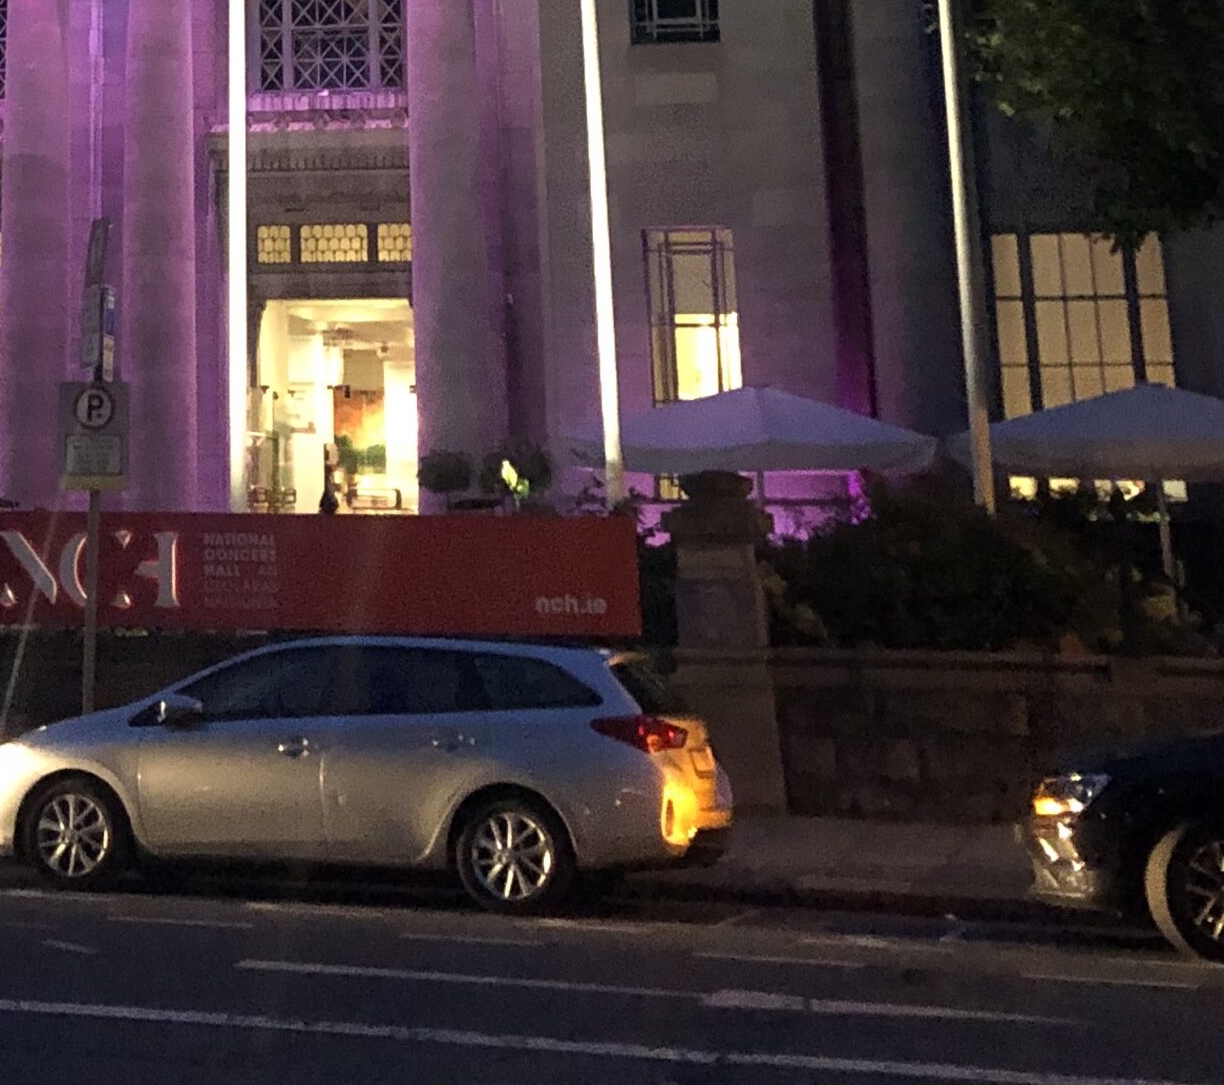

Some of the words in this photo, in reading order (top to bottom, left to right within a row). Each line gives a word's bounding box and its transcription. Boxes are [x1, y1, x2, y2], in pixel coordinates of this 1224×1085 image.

[86, 395, 105, 423] P
[202, 531, 275, 547] NATIONAL
[202, 563, 241, 577] HALL
[535, 593, 608, 615] nch.ie
